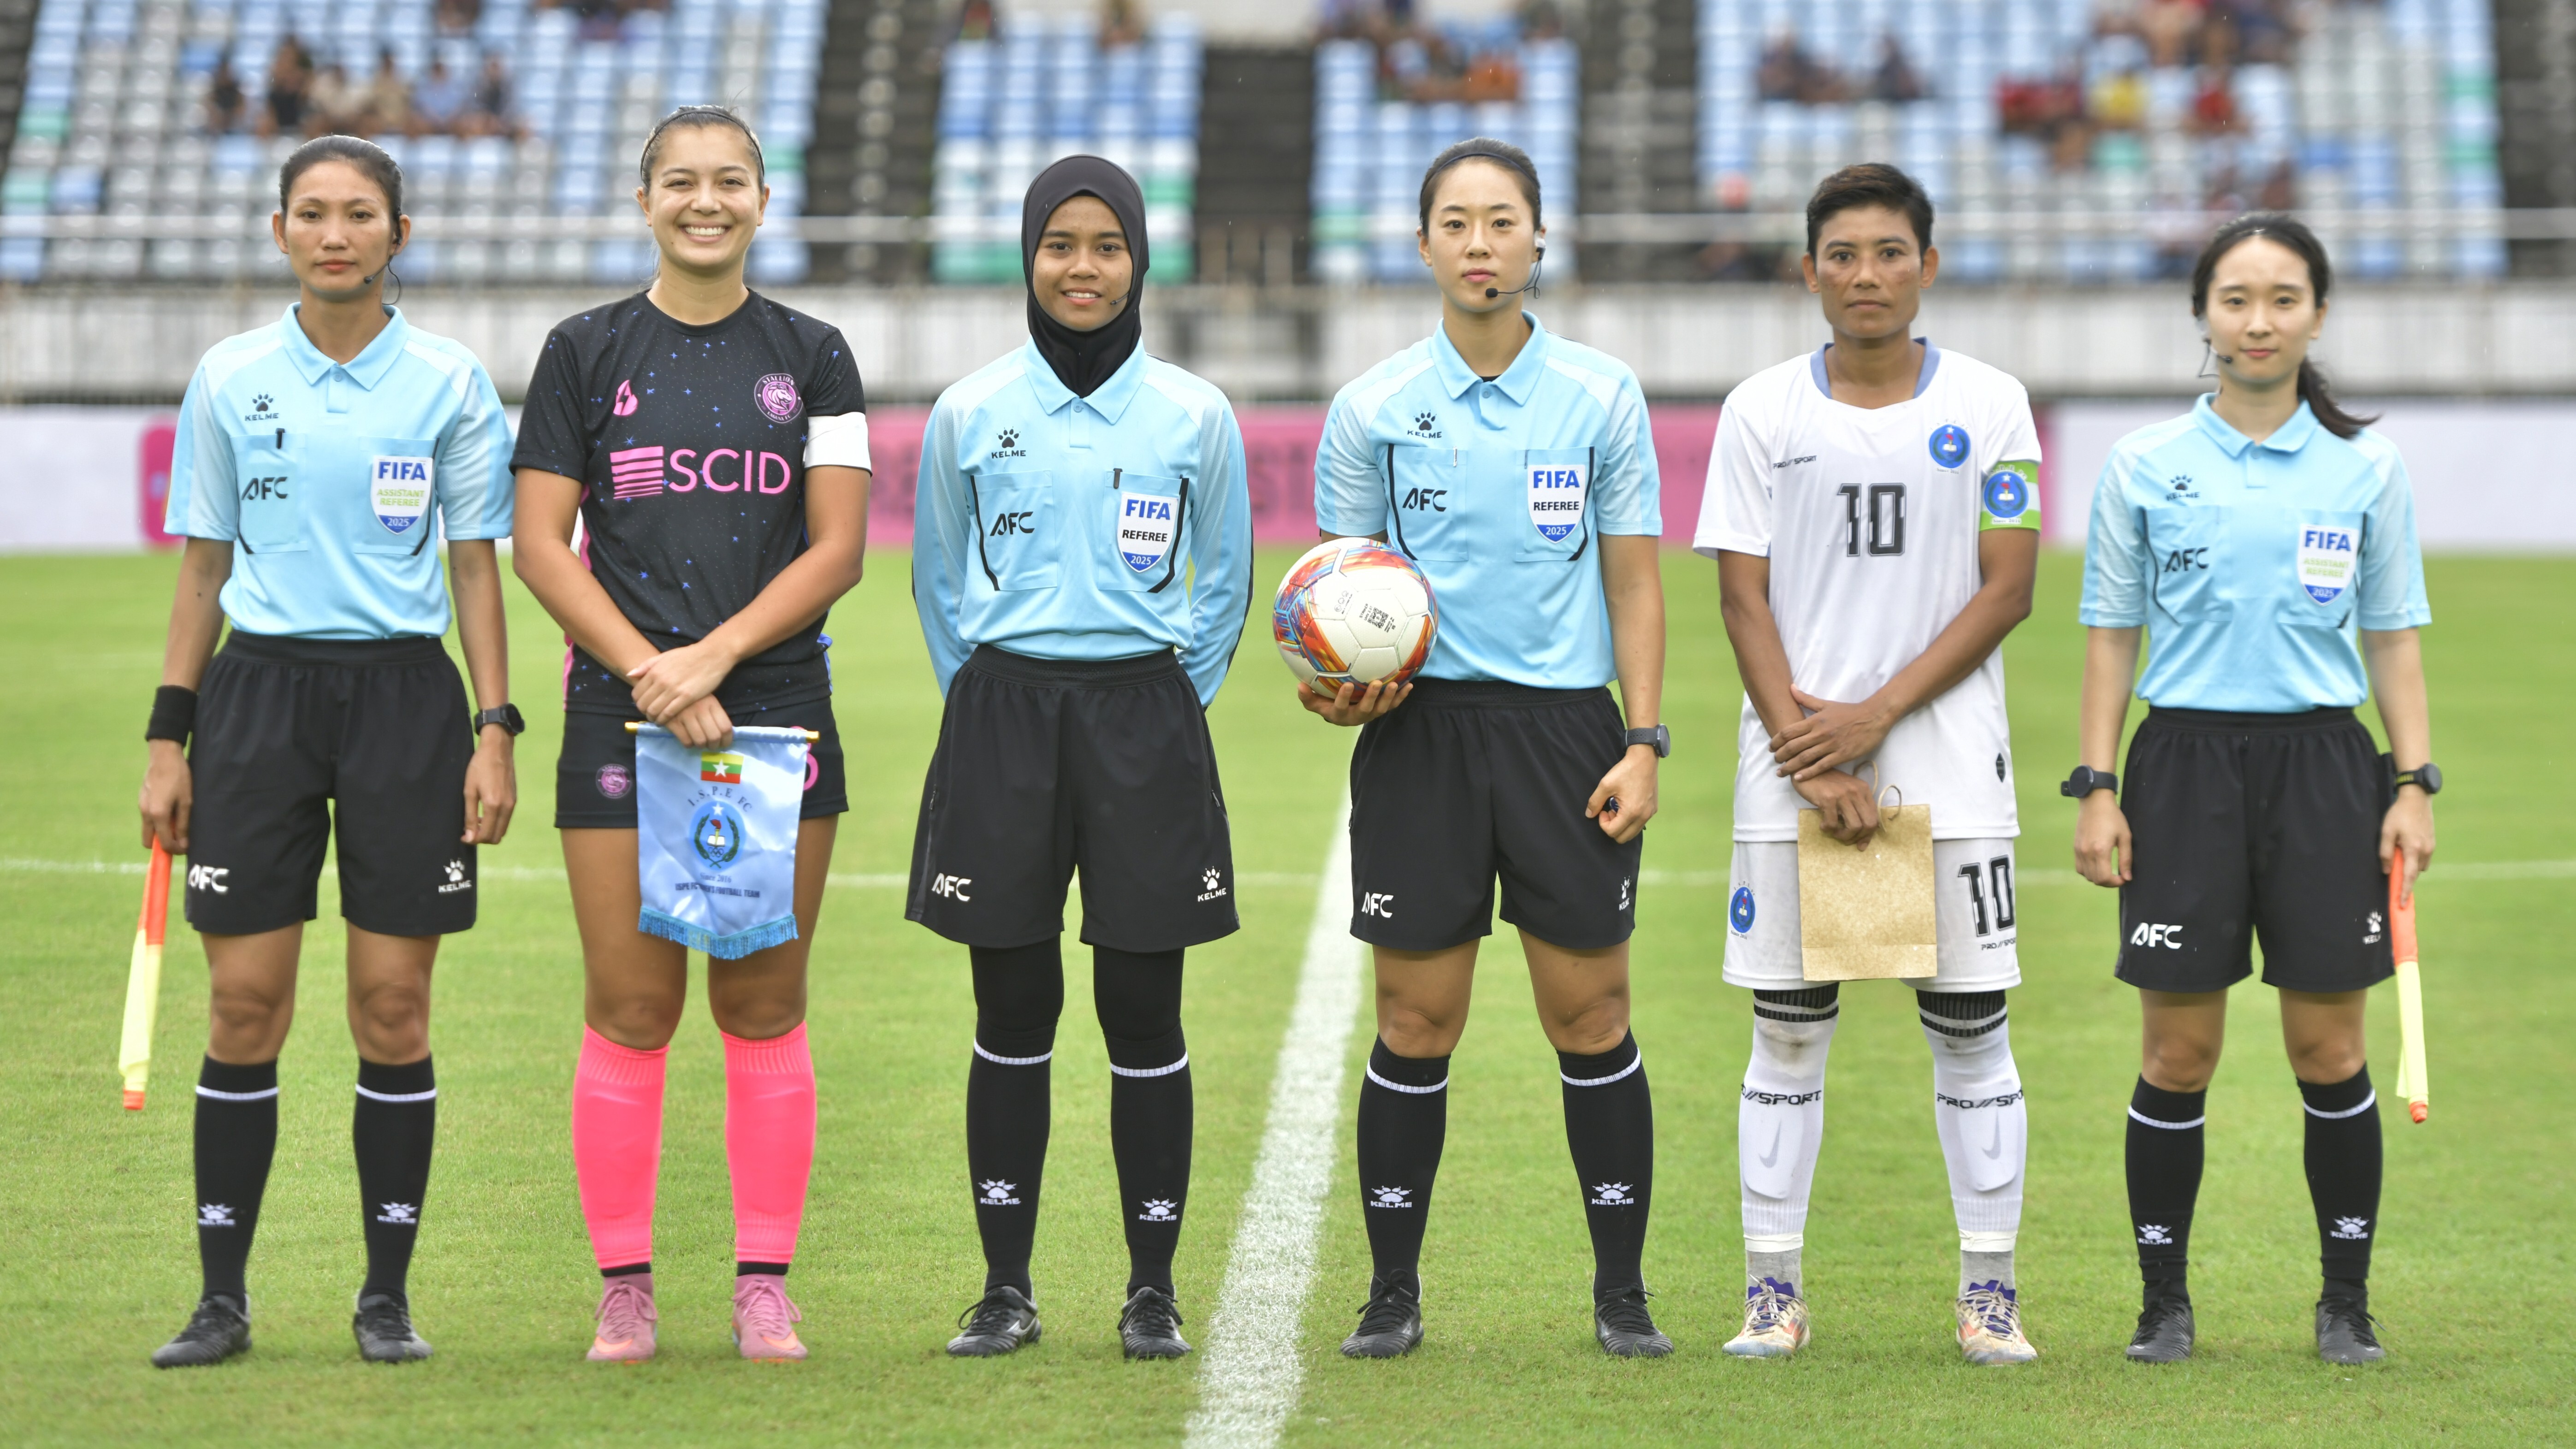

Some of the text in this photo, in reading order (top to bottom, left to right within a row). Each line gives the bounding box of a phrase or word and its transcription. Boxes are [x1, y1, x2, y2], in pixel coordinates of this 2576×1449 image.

[762, 376, 794, 385] STALLION
[244, 413, 279, 421] KELME
[767, 411, 785, 421] LAGUNA
[1407, 430, 1442, 438] KELME
[991, 450, 1026, 459] KELME
[377, 461, 426, 480] FIFA
[669, 449, 791, 494] SCID
[1534, 470, 1580, 488] FIFA
[241, 477, 288, 500] AFC
[377, 488, 425, 498] ASSISTANT
[379, 498, 420, 507] REFEREE
[1402, 488, 1448, 512] AFC
[1534, 501, 1579, 511] REFEREE
[1125, 499, 1171, 520] FIFA
[387, 518, 410, 526] 2025
[989, 511, 1035, 536] AFC
[1837, 483, 1907, 557] 10
[1122, 529, 1167, 542] REFEREE
[2305, 530, 2351, 551] FIFA
[1131, 556, 1152, 565] 2025
[2164, 546, 2209, 572] AFC
[2303, 557, 2350, 568] ASSISTANT
[2306, 567, 2345, 578] REFEREE
[2313, 587, 2335, 597] 2025
[1359, 603, 1368, 618] STRIKER
[687, 786, 752, 812] I.S.P.E FC
[188, 863, 230, 893] AFC
[700, 872, 732, 883] Since 2016
[438, 880, 472, 893] KELME
[931, 873, 971, 901] AFC
[744, 889, 760, 898] TEAM
[1198, 887, 1226, 902] KELME
[1958, 854, 2015, 937] 10
[1362, 892, 1394, 918] AFC
[2130, 922, 2183, 949] AFC
[980, 1197, 1021, 1206] KELME
[1370, 1200, 1412, 1208] KELME
[2330, 1230, 2369, 1240] KELME
